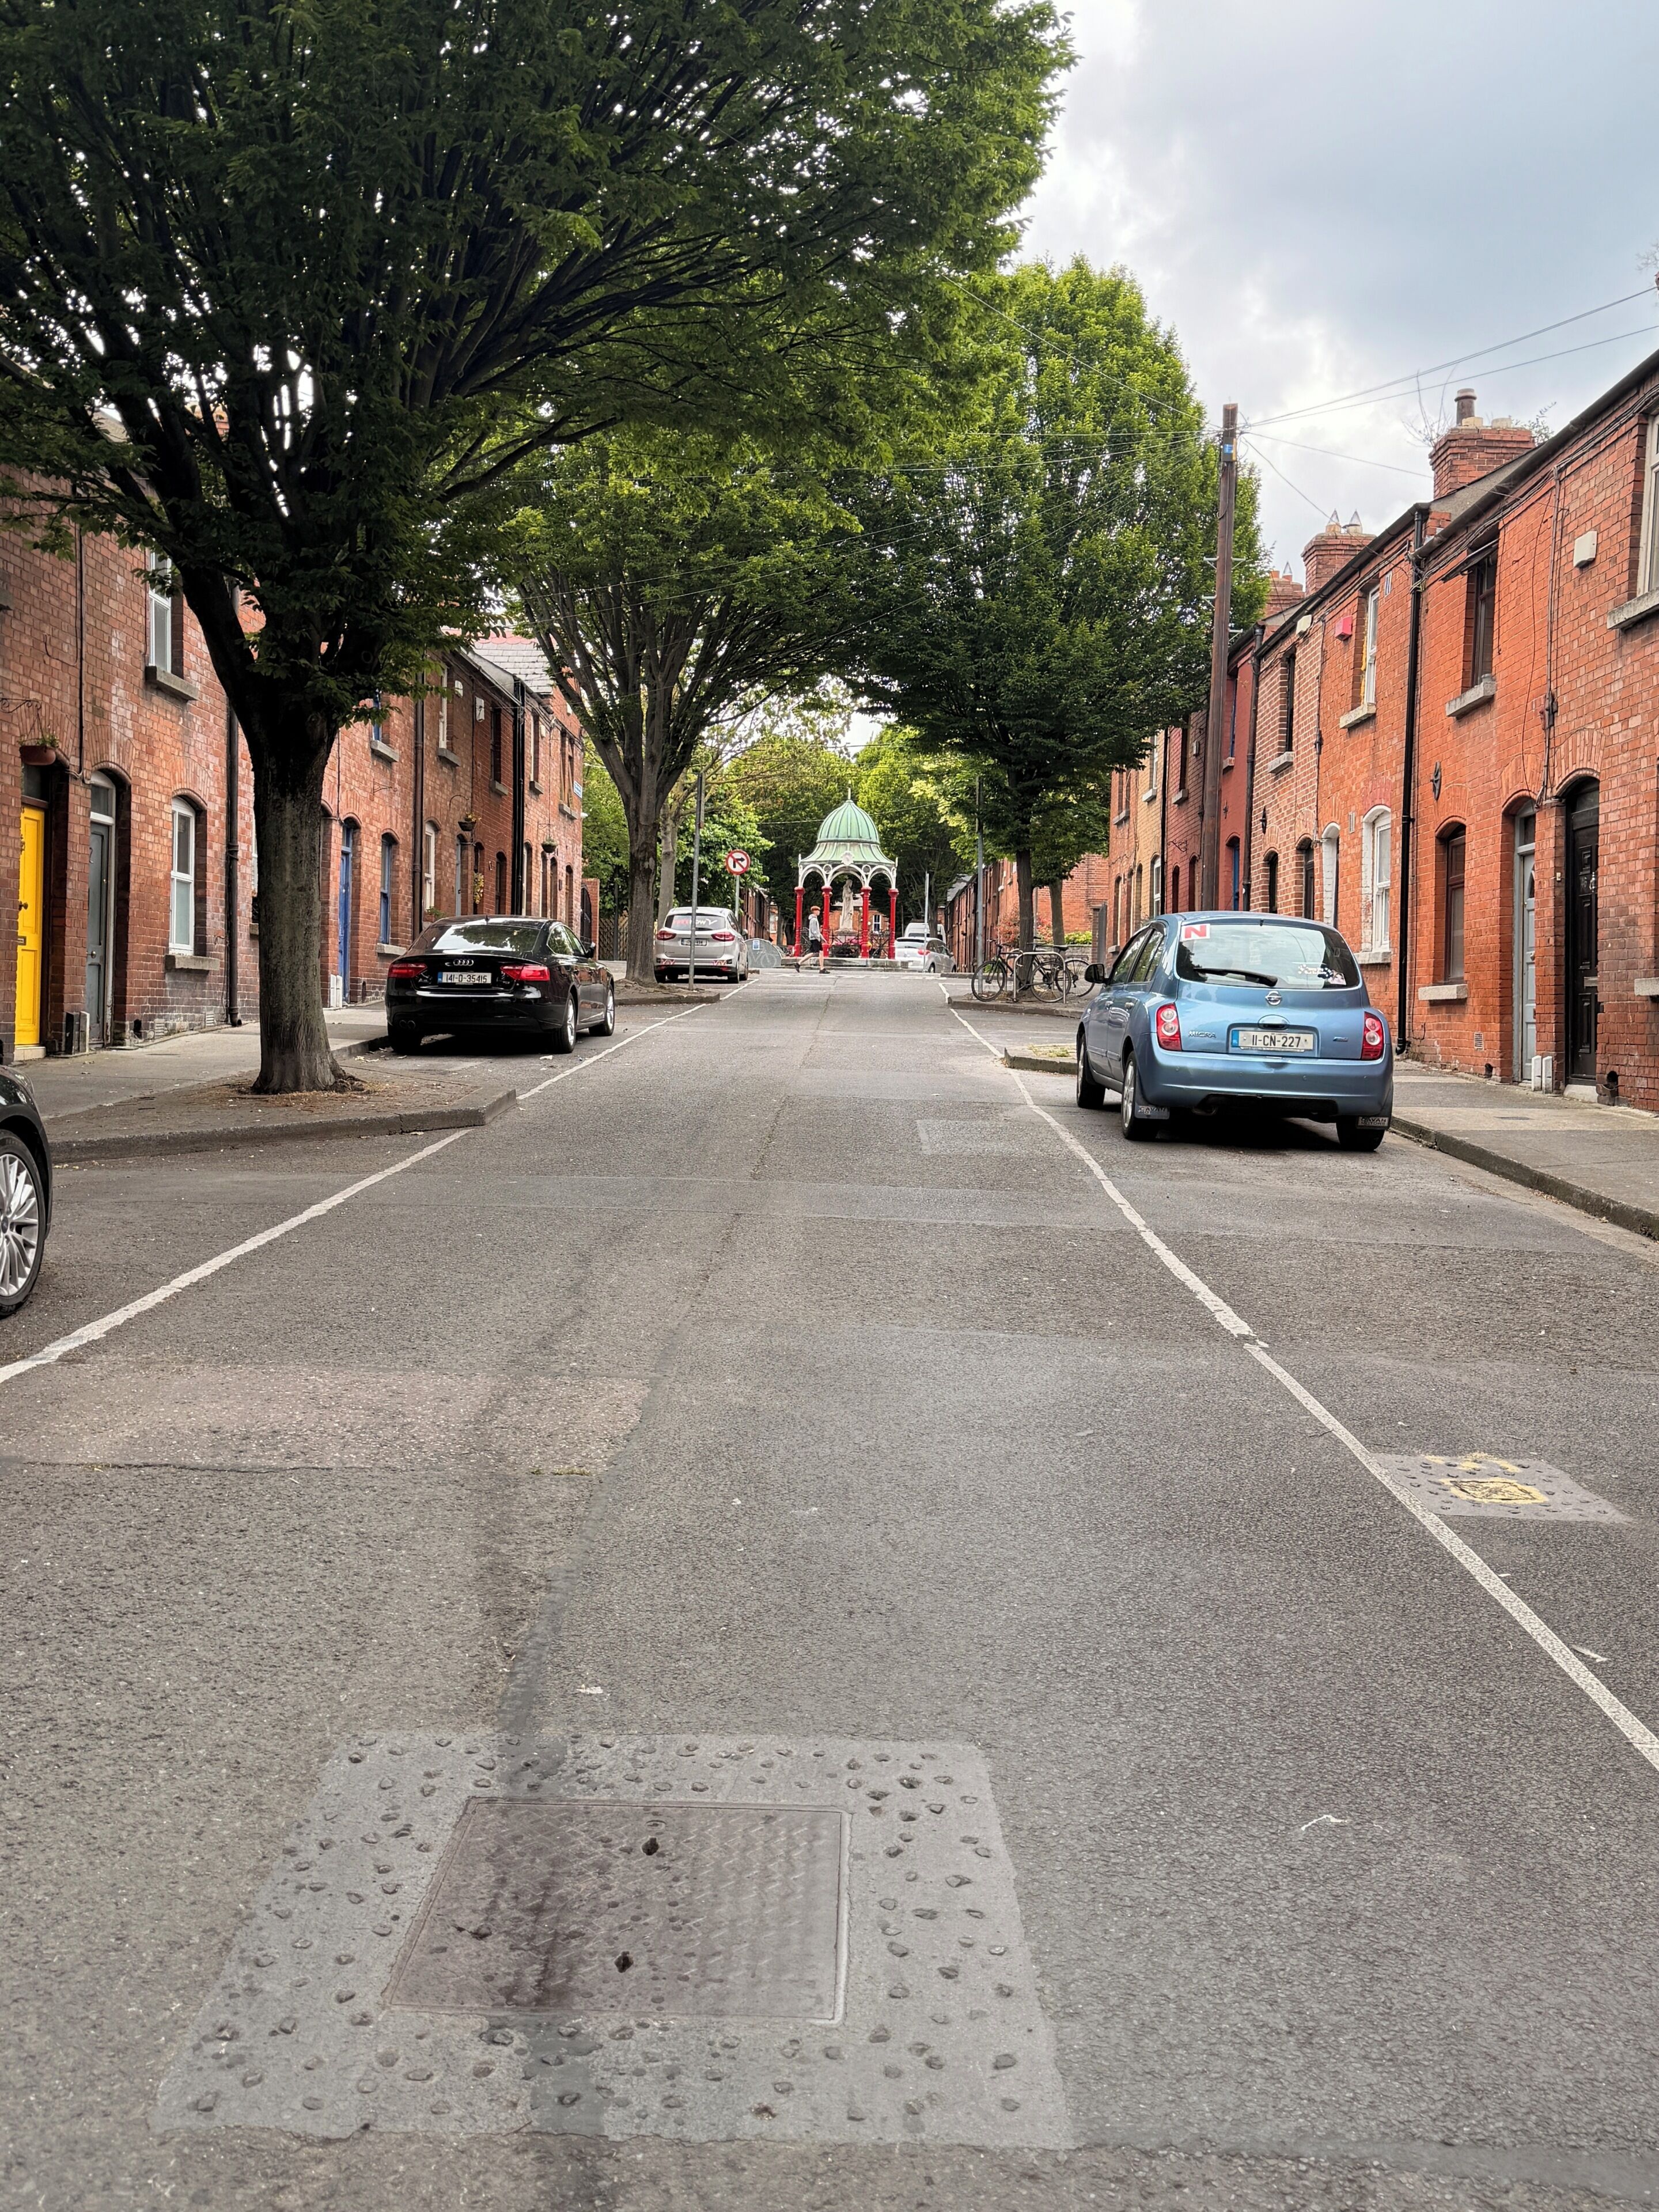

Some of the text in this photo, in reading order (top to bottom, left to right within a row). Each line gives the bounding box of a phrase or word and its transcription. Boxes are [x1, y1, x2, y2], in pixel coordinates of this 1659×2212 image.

[1184, 925, 1207, 939] N
[446, 974, 487, 983] 141-D-35415
[1188, 1031, 1217, 1039] MICRA
[1252, 1035, 1301, 1048] 11-CN-227
